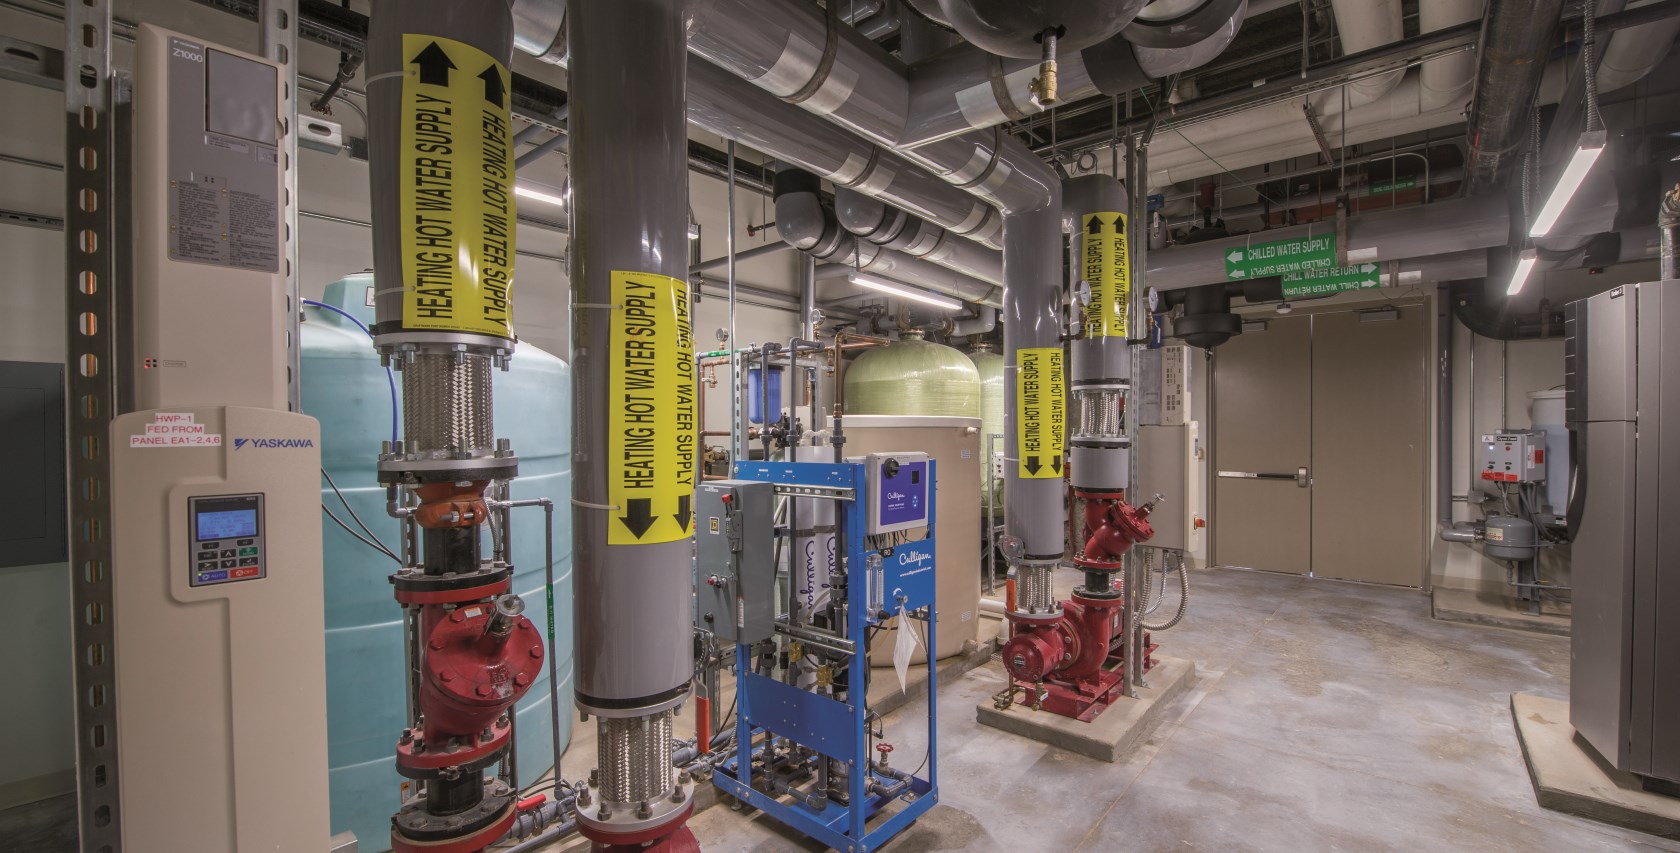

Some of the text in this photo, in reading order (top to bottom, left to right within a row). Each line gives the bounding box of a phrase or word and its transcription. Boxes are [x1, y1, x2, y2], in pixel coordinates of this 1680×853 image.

[172, 48, 203, 62] Z1000
[415, 93, 453, 319] HEATING HOT WATER SUPPLY
[482, 109, 508, 327] HEATING HOT WATER SUPPLY
[1087, 239, 1102, 264] SUPPLY
[1114, 238, 1125, 267] HEATING
[1247, 238, 1329, 261] CHILLED WATER SUPPLY
[1088, 265, 1102, 290] WATER
[1114, 268, 1125, 283] HOT
[1250, 258, 1331, 276] CHILLED WATER SUPPLY
[1283, 265, 1359, 282] CHILL WATER RETURN
[1114, 283, 1126, 306] WATER
[1284, 281, 1360, 296] CHILL WATER RETURN
[625, 281, 656, 336] SUPPLY
[624, 341, 655, 390] WATER
[677, 289, 692, 485] HEATING HOT WATER SUPPLY
[624, 394, 655, 423] HOT
[1023, 353, 1040, 452] HEATING HOT WATER SUPPLY
[1050, 352, 1062, 450] HEATING HOT WATER SUPPLY
[147, 425, 203, 433] FED FROM
[156, 415, 192, 423] HWP-1
[132, 436, 220, 445] PANEL EA1-2,4,6
[252, 438, 313, 448] YASKAWA
[623, 427, 655, 489] HEATING
[887, 492, 905, 501] Culligan
[899, 551, 930, 567] Culligan
